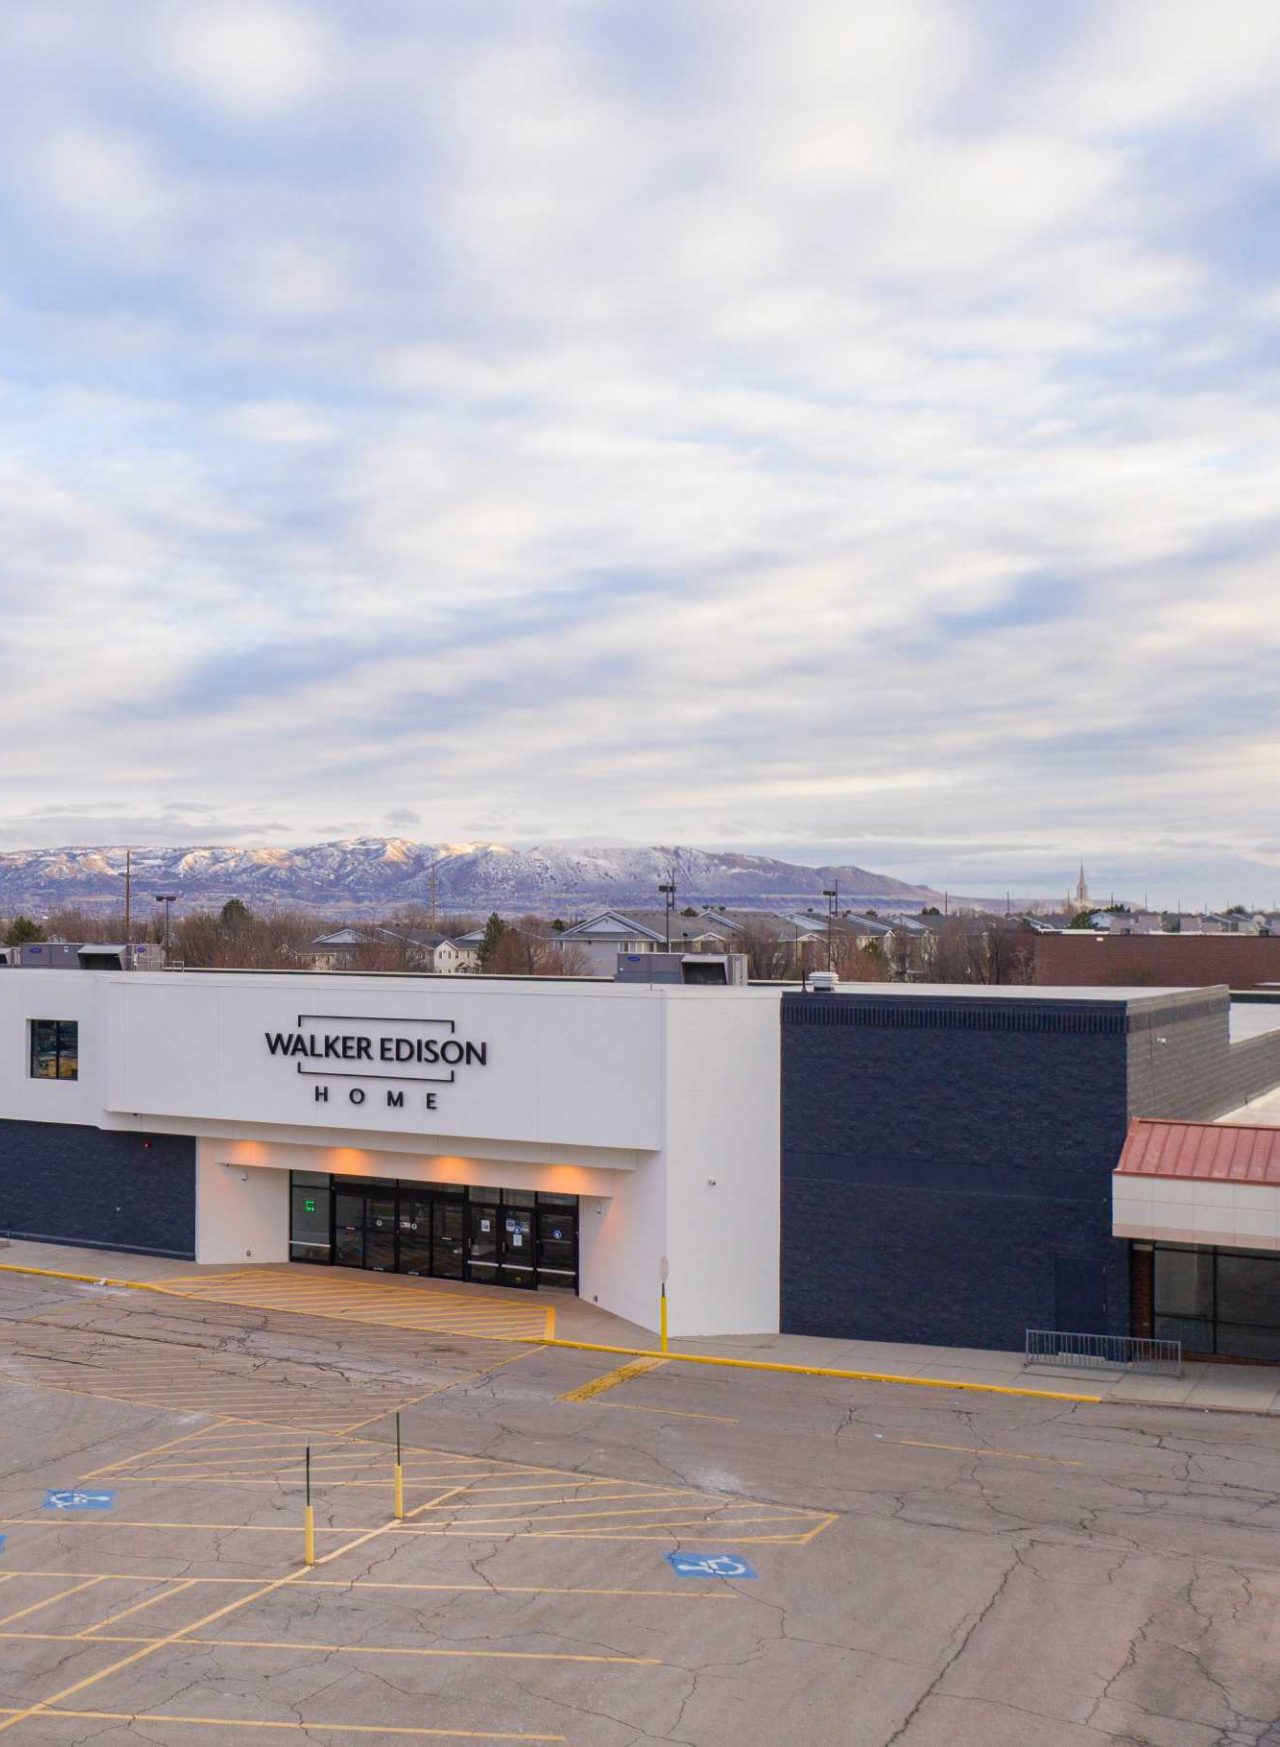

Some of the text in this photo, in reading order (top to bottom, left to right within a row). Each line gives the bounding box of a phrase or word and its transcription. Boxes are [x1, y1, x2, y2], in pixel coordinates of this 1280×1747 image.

[265, 1032, 487, 1067] WALKER EDISON
[314, 1085, 437, 1110] HOME
